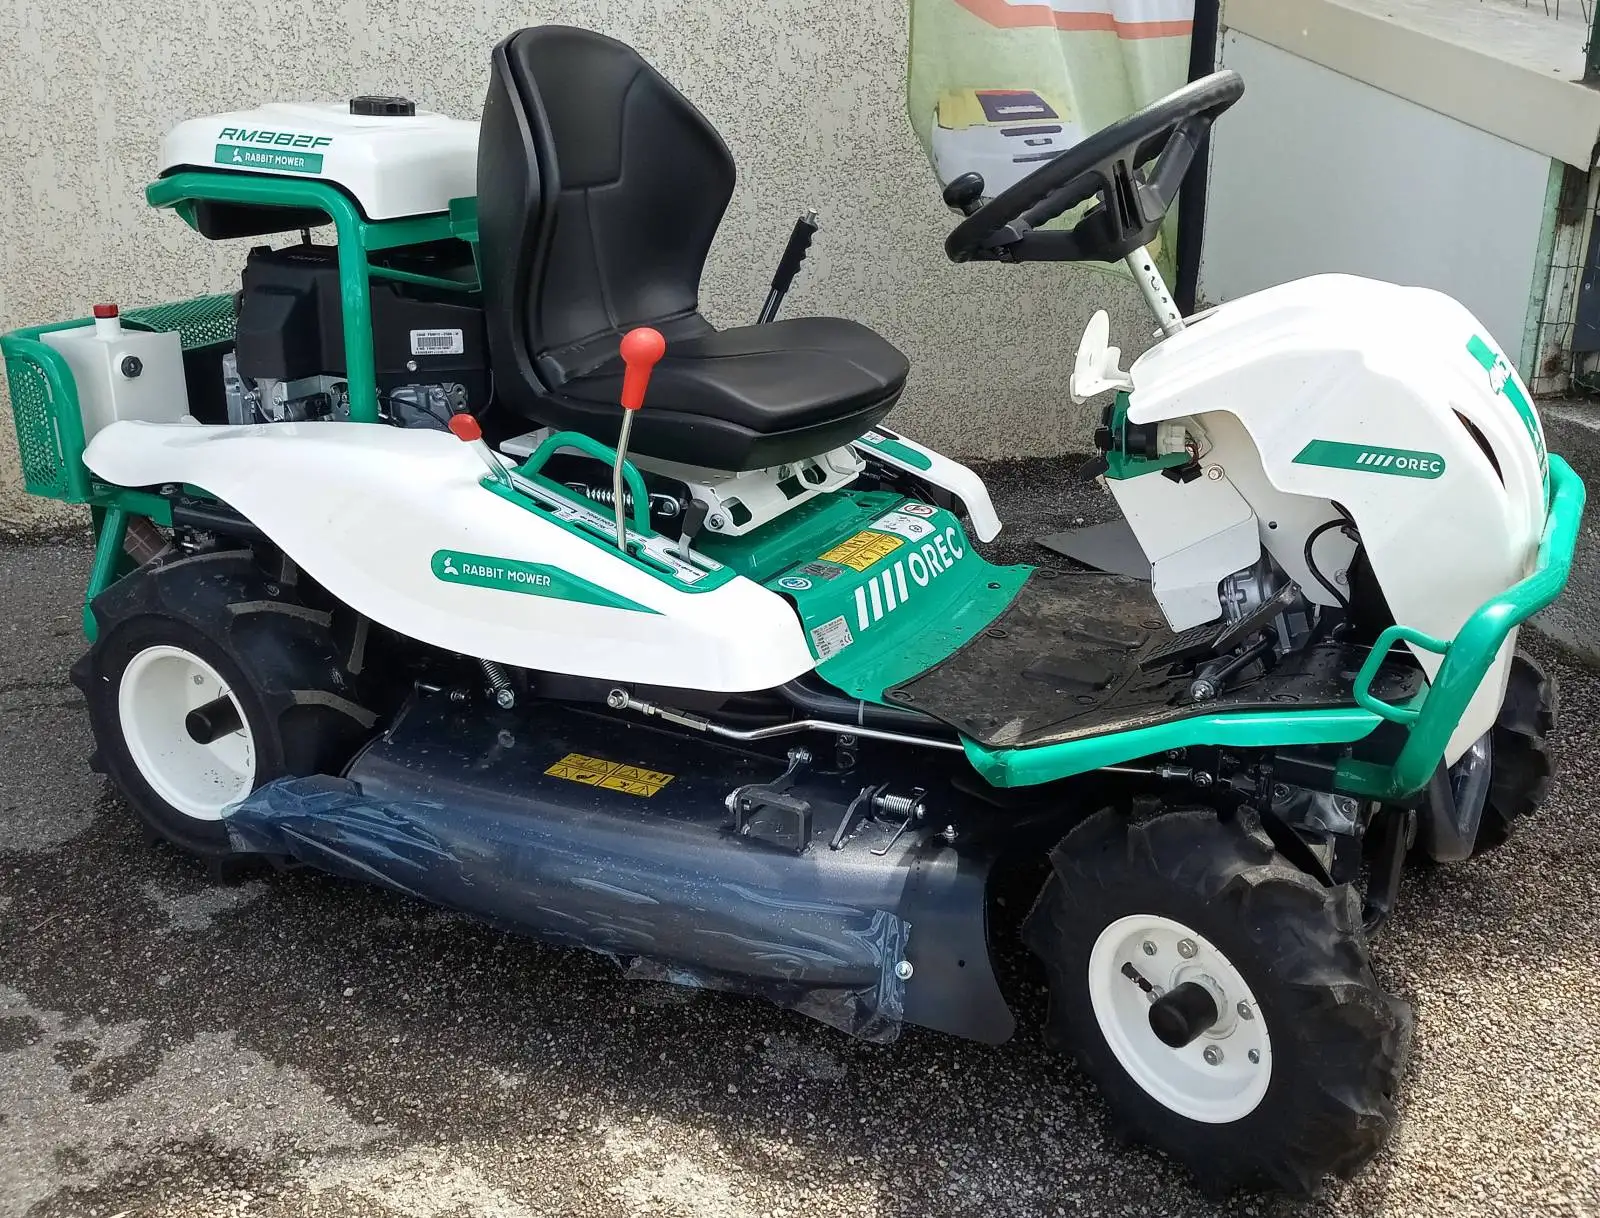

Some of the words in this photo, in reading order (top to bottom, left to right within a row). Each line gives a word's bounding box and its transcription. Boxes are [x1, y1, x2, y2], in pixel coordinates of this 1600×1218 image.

[218, 127, 333, 148] RM982F
[245, 152, 274, 164] RABBIT
[275, 155, 305, 168] MOWER
[1395, 457, 1441, 473] OREC
[907, 526, 963, 587] OREC
[462, 563, 504, 579] RABBIT
[507, 570, 551, 587] MOWER
